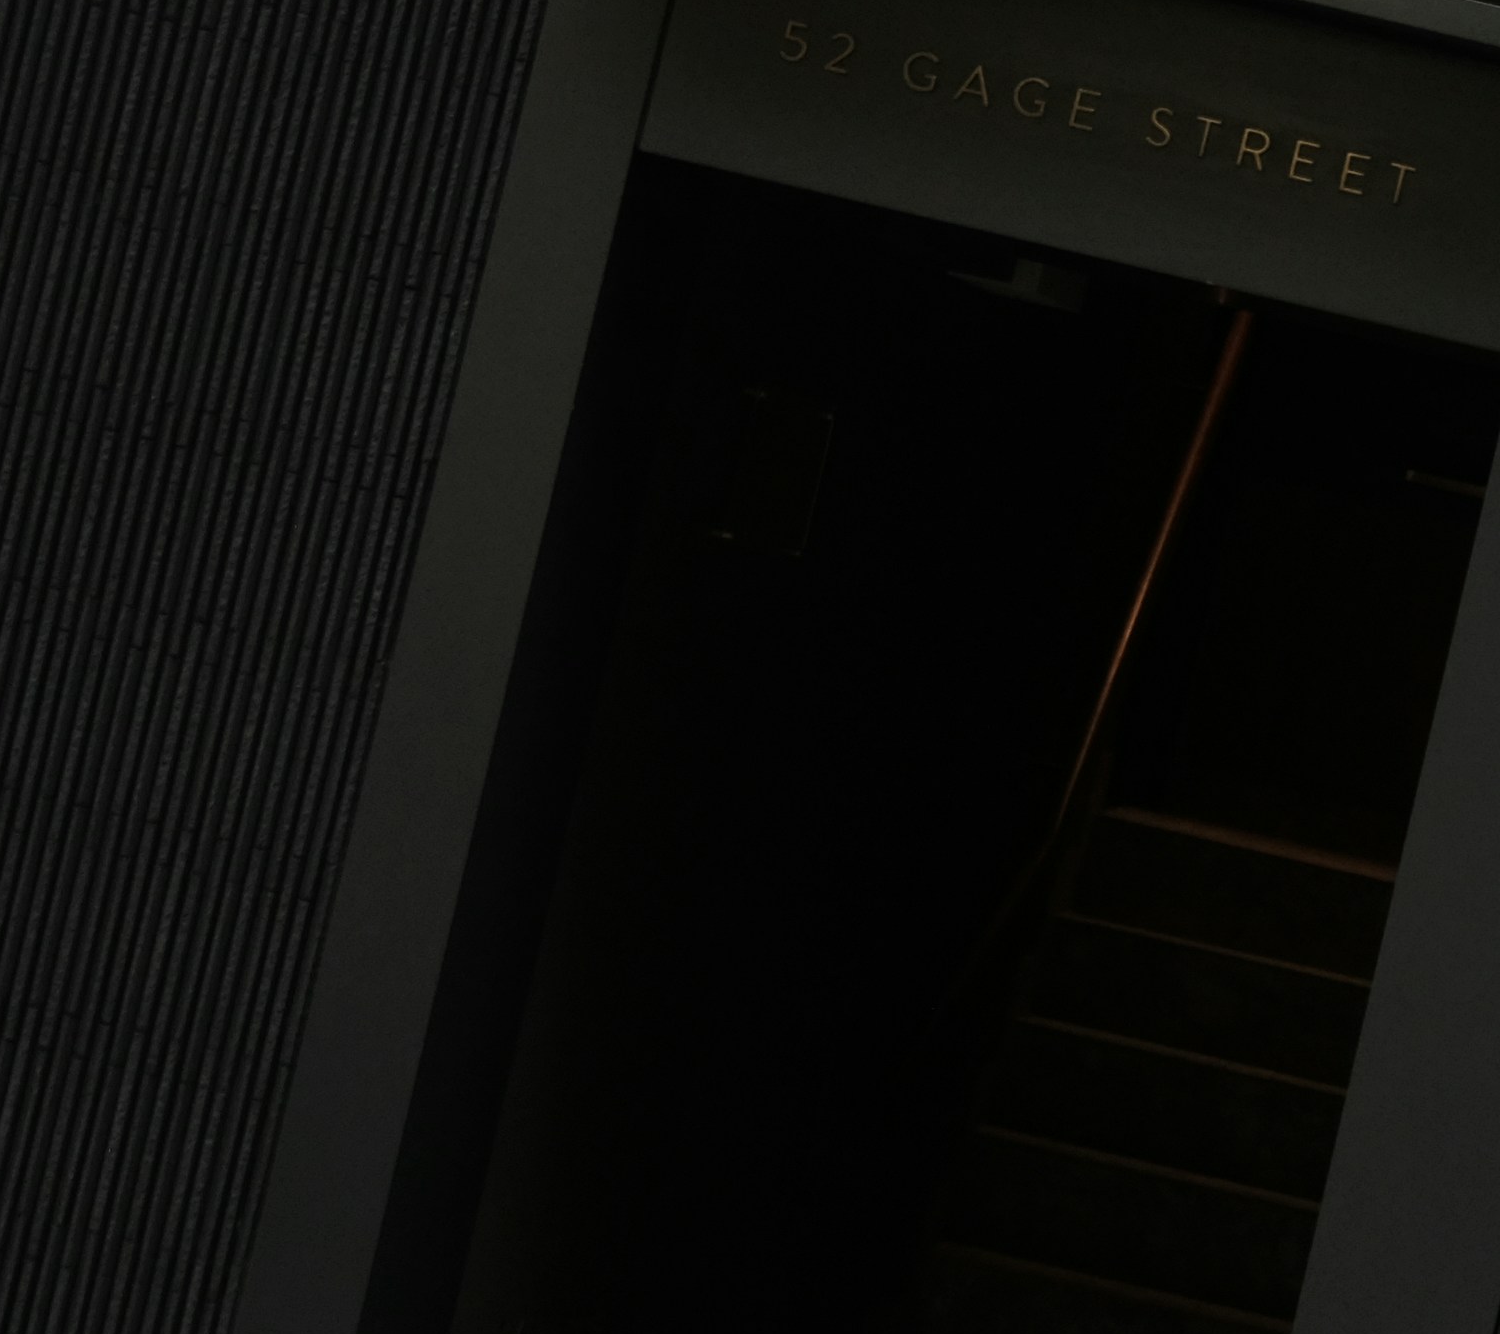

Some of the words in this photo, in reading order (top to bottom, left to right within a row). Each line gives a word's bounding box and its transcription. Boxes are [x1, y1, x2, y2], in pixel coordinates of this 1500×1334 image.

[779, 19, 856, 75] 52
[902, 51, 1102, 133] GAGE
[1145, 106, 1417, 205] STREET
